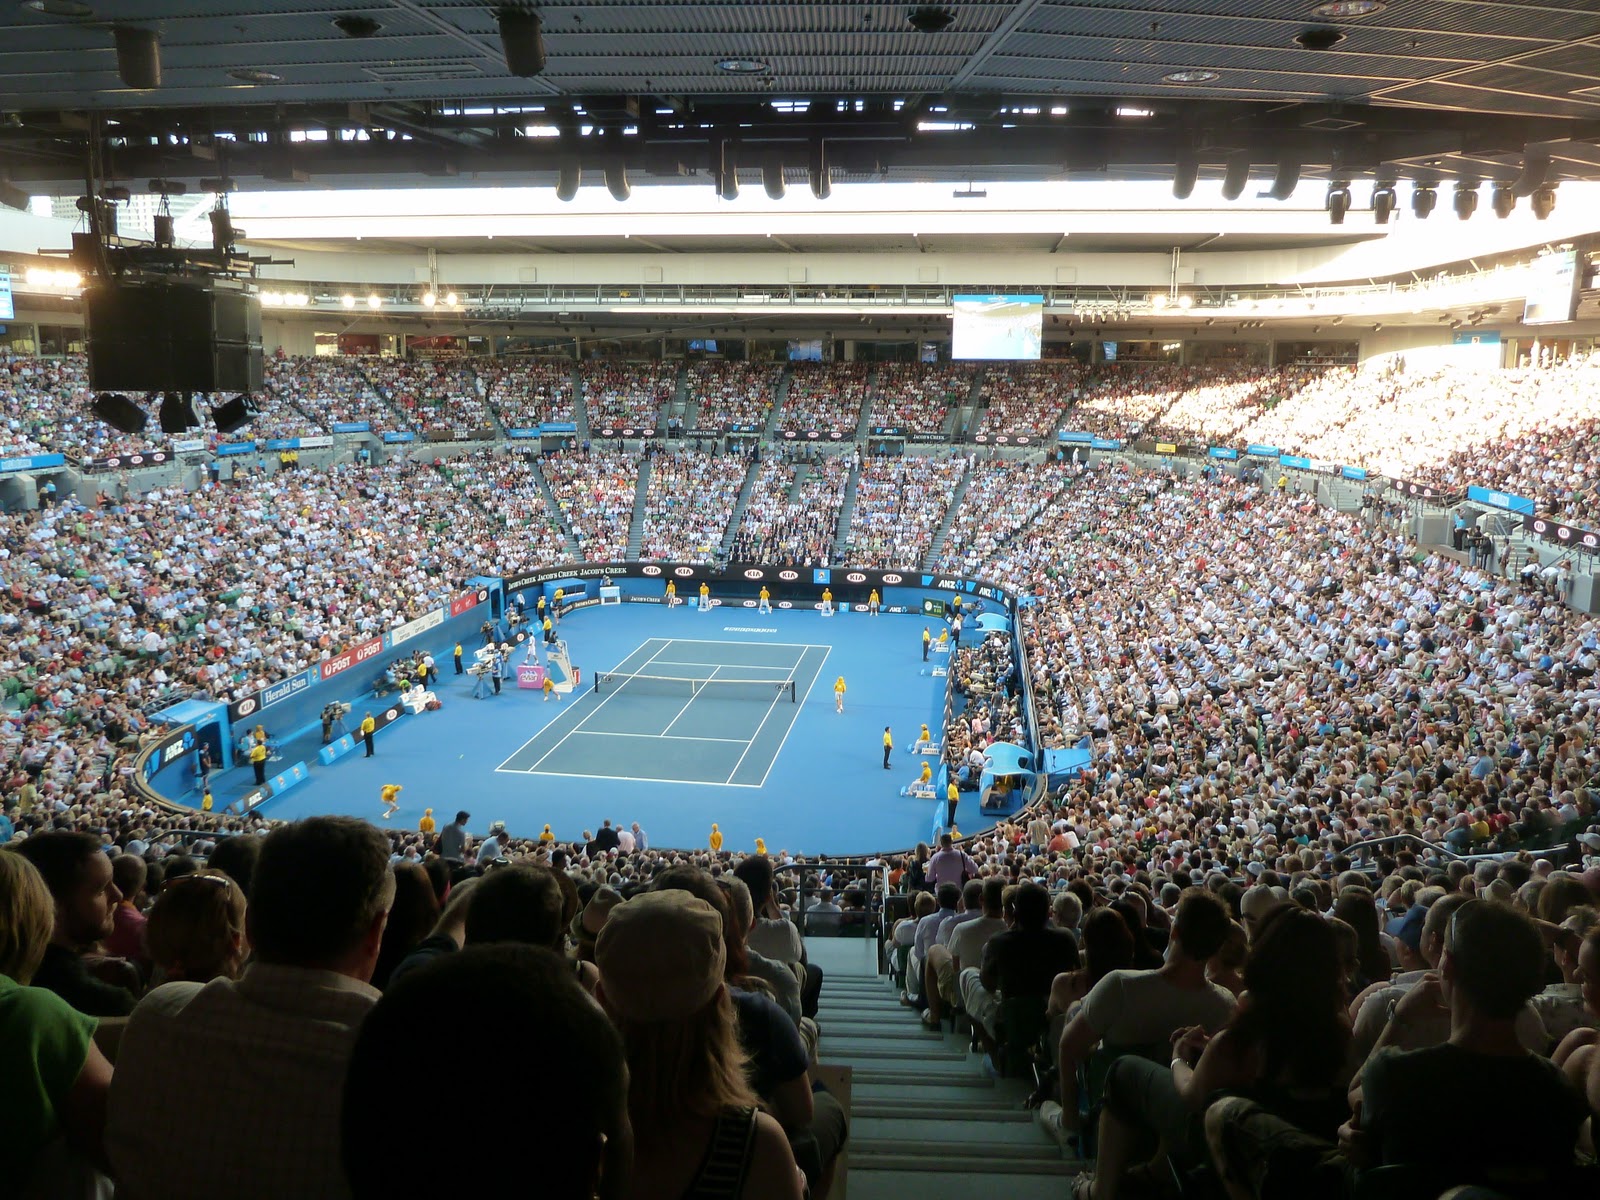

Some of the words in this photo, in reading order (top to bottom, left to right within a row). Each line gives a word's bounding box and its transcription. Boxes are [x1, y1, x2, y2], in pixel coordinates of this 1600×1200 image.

[537, 572, 558, 581] JACOB'S
[558, 570, 578, 578] CREEK
[938, 580, 956, 589] ANZ
[979, 587, 992, 597] ANZ
[364, 642, 380, 658] POST
[332, 656, 351, 673] POST
[265, 682, 290, 703] Herald
[291, 678, 306, 690] Sun
[240, 700, 254, 713] KIA
